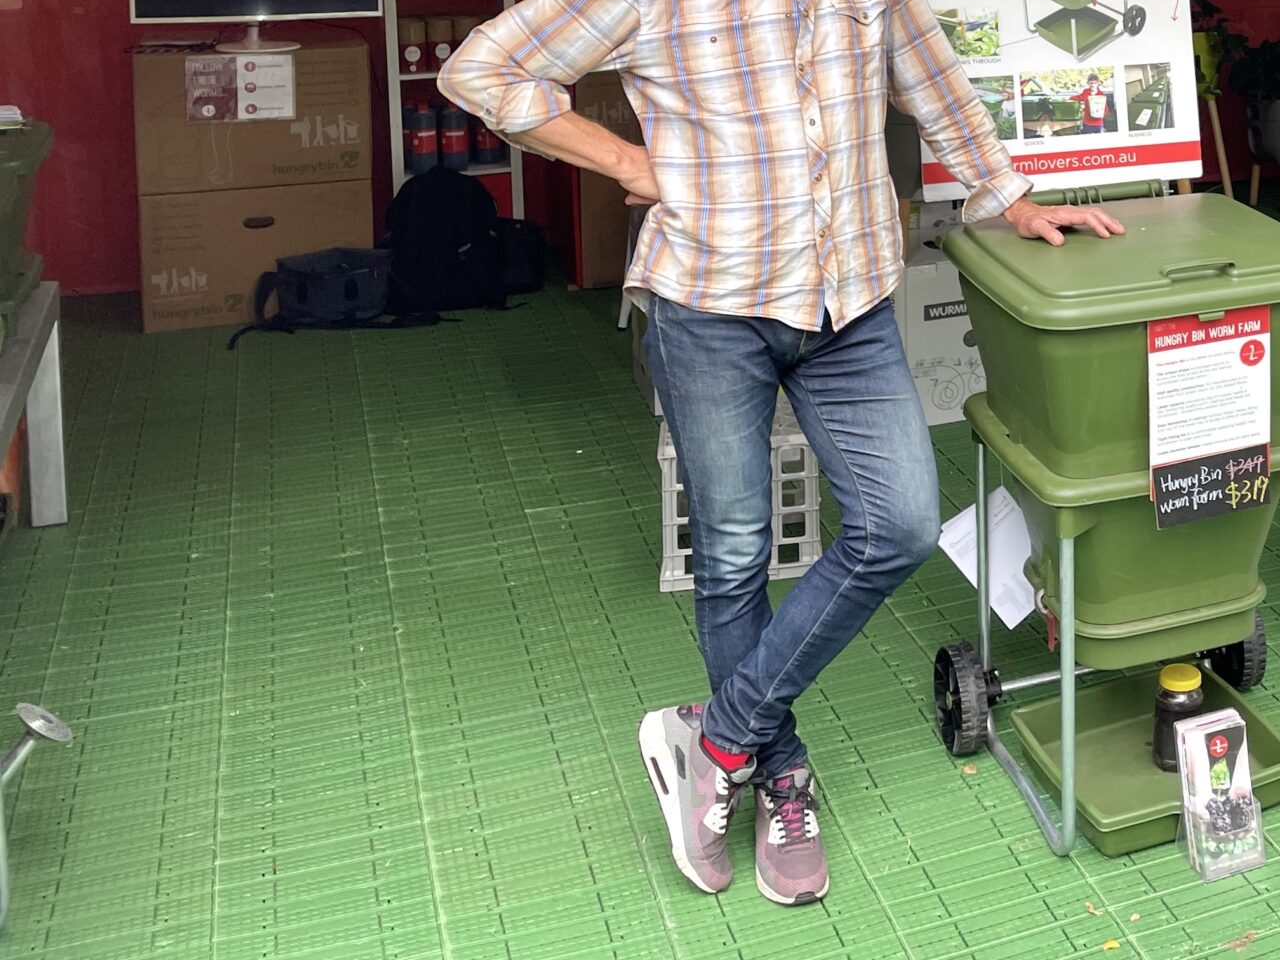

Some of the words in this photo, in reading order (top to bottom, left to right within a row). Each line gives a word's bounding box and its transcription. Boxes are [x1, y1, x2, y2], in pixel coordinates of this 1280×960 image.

[1013, 152, 1137, 172] rmlovers.com.au
[1154, 332, 1189, 348] HUNGRY
[1191, 329, 1205, 342] BIN
[1208, 324, 1235, 339] WORM
[1238, 320, 1261, 334] FARM
[1160, 473, 1199, 495] Hungry
[1200, 466, 1222, 485] Bin
[1225, 475, 1269, 509] $319
